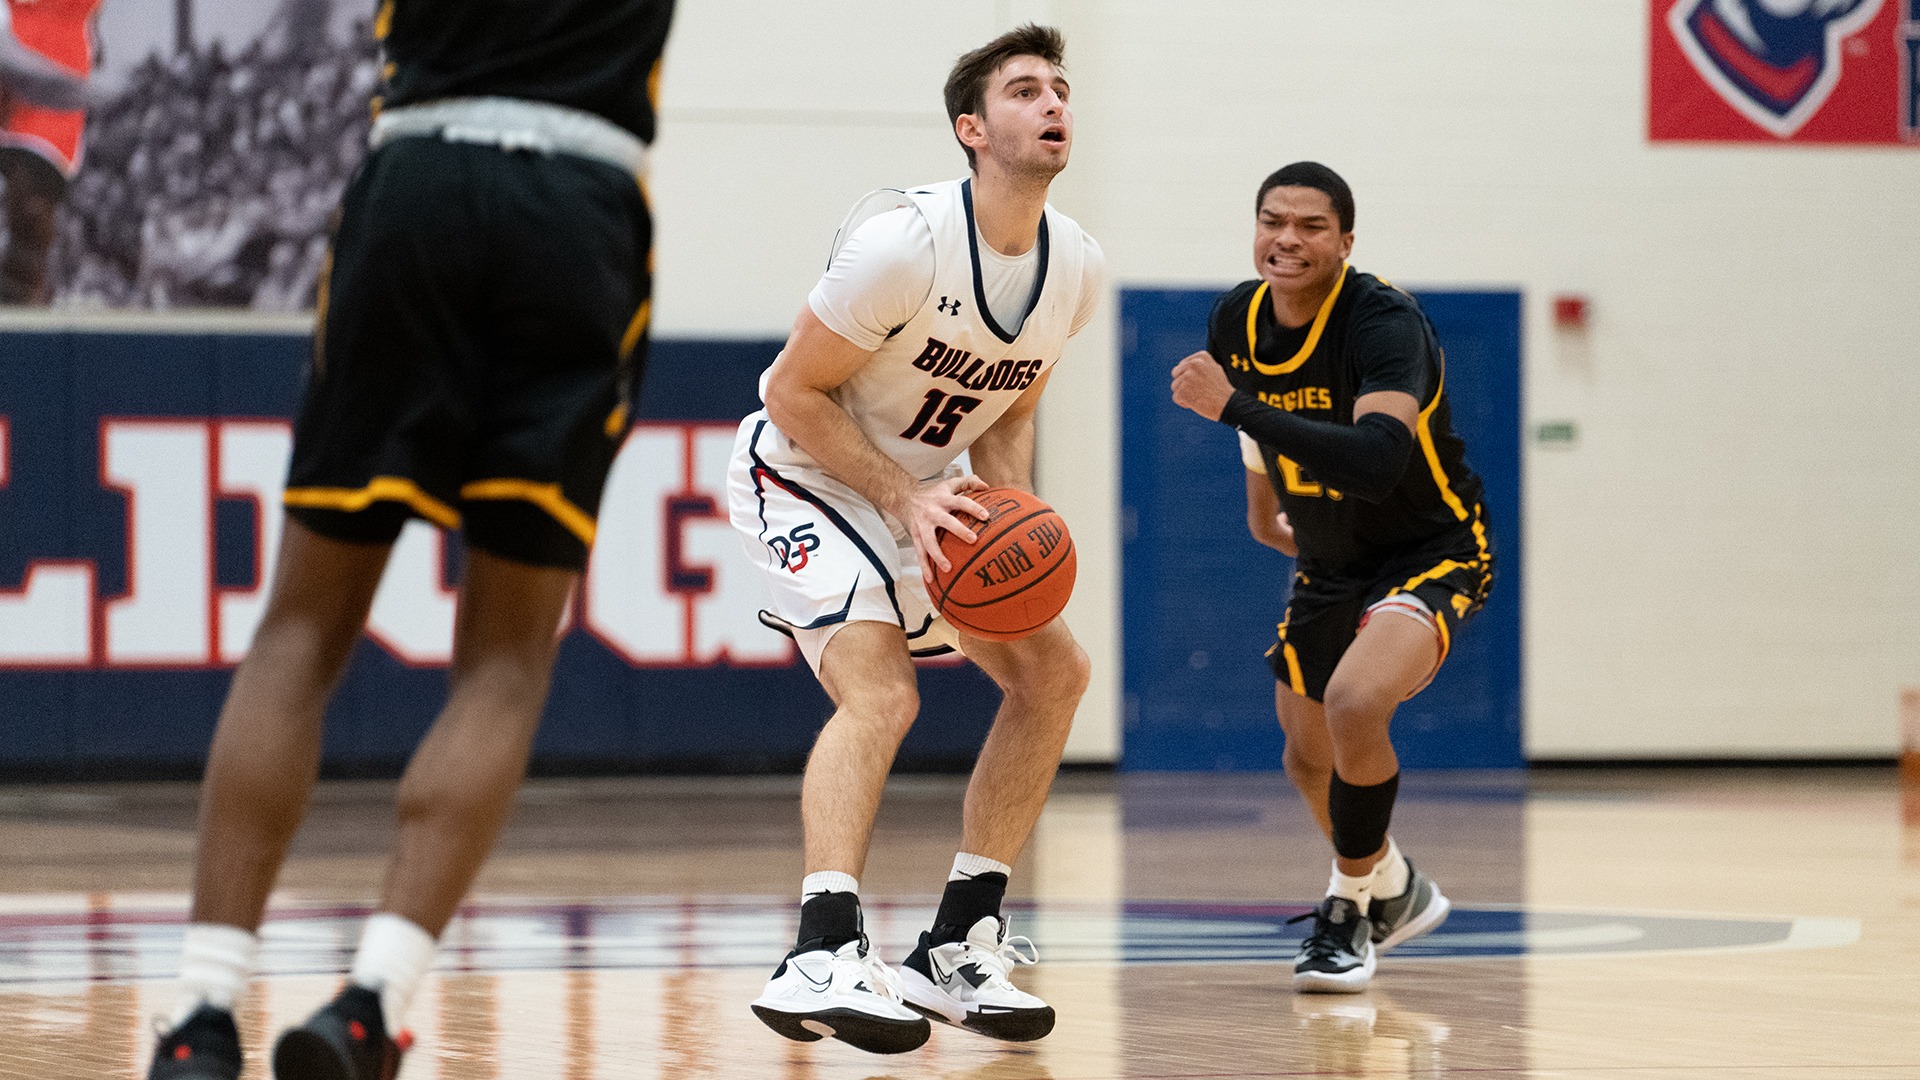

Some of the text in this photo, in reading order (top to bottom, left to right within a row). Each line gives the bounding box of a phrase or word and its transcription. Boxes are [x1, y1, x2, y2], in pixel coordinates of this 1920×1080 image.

[911, 337, 1043, 392] BULLDOGS
[899, 388, 984, 448] 15
[974, 519, 1063, 588] THE ROCK
